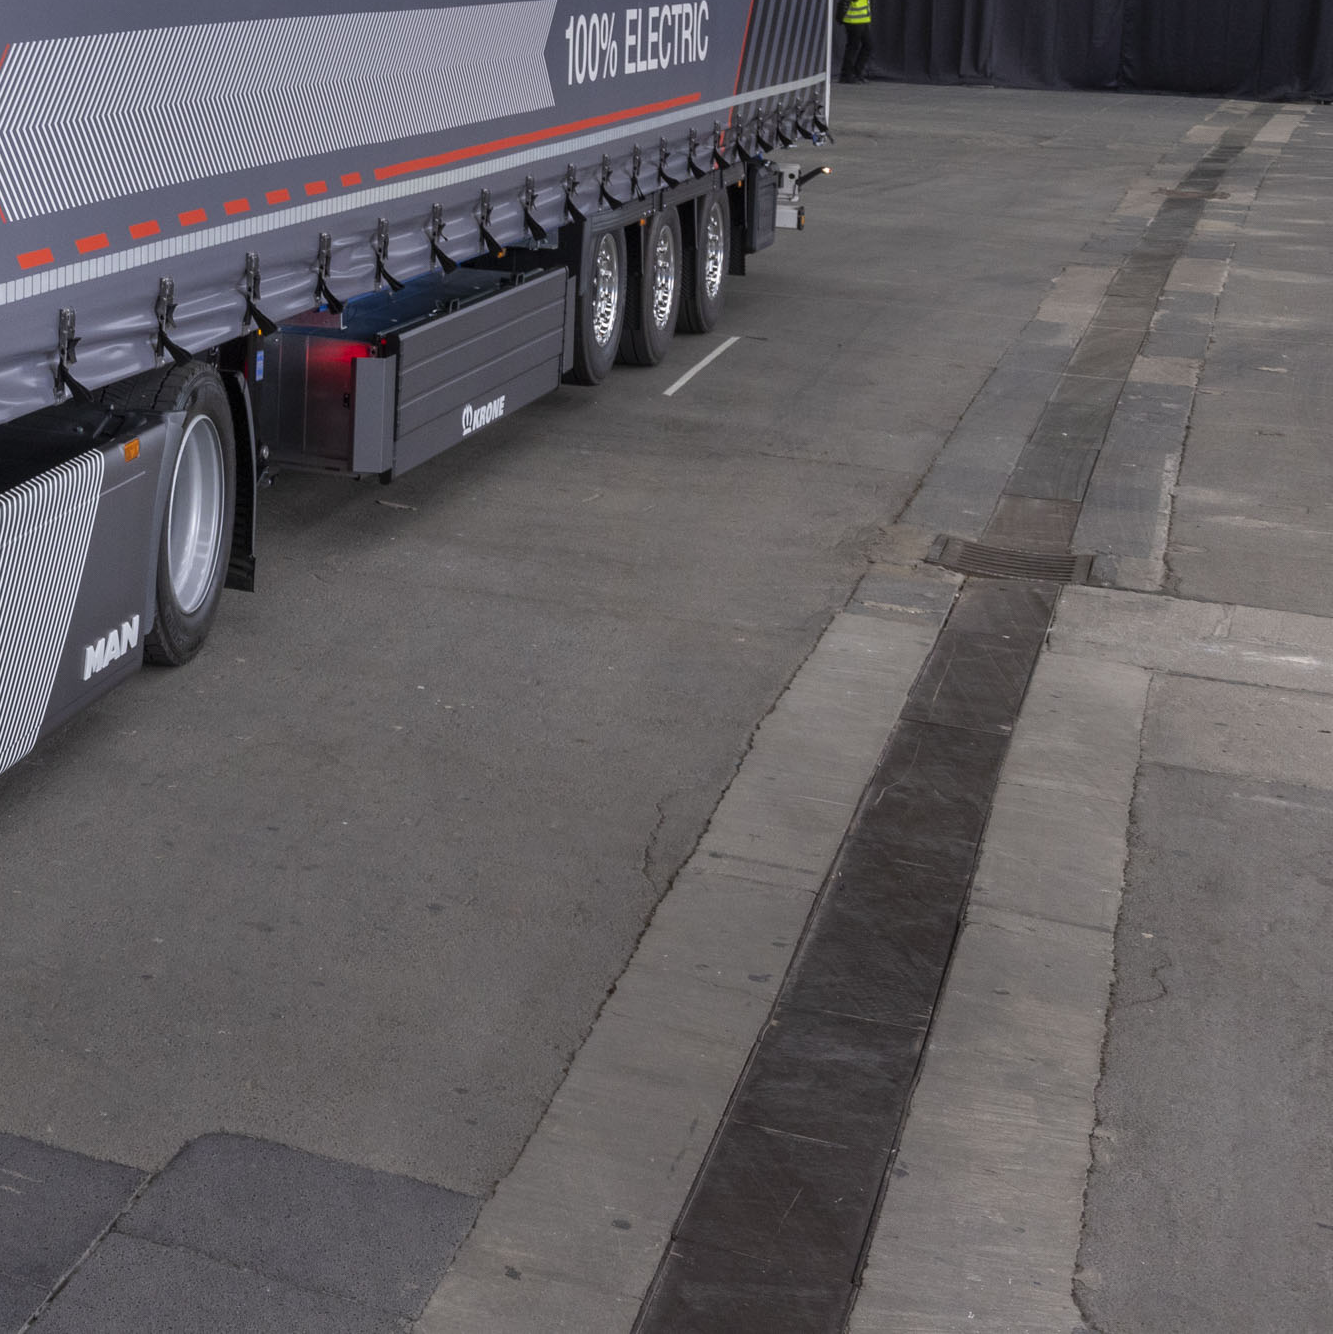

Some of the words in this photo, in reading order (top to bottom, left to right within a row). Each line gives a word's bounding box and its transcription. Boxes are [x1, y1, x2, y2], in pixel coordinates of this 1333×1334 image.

[565, 12, 618, 86] 100%
[624, 0, 709, 74] ELECTRIC
[472, 394, 506, 432] KRONE
[83, 614, 140, 681] MAN
